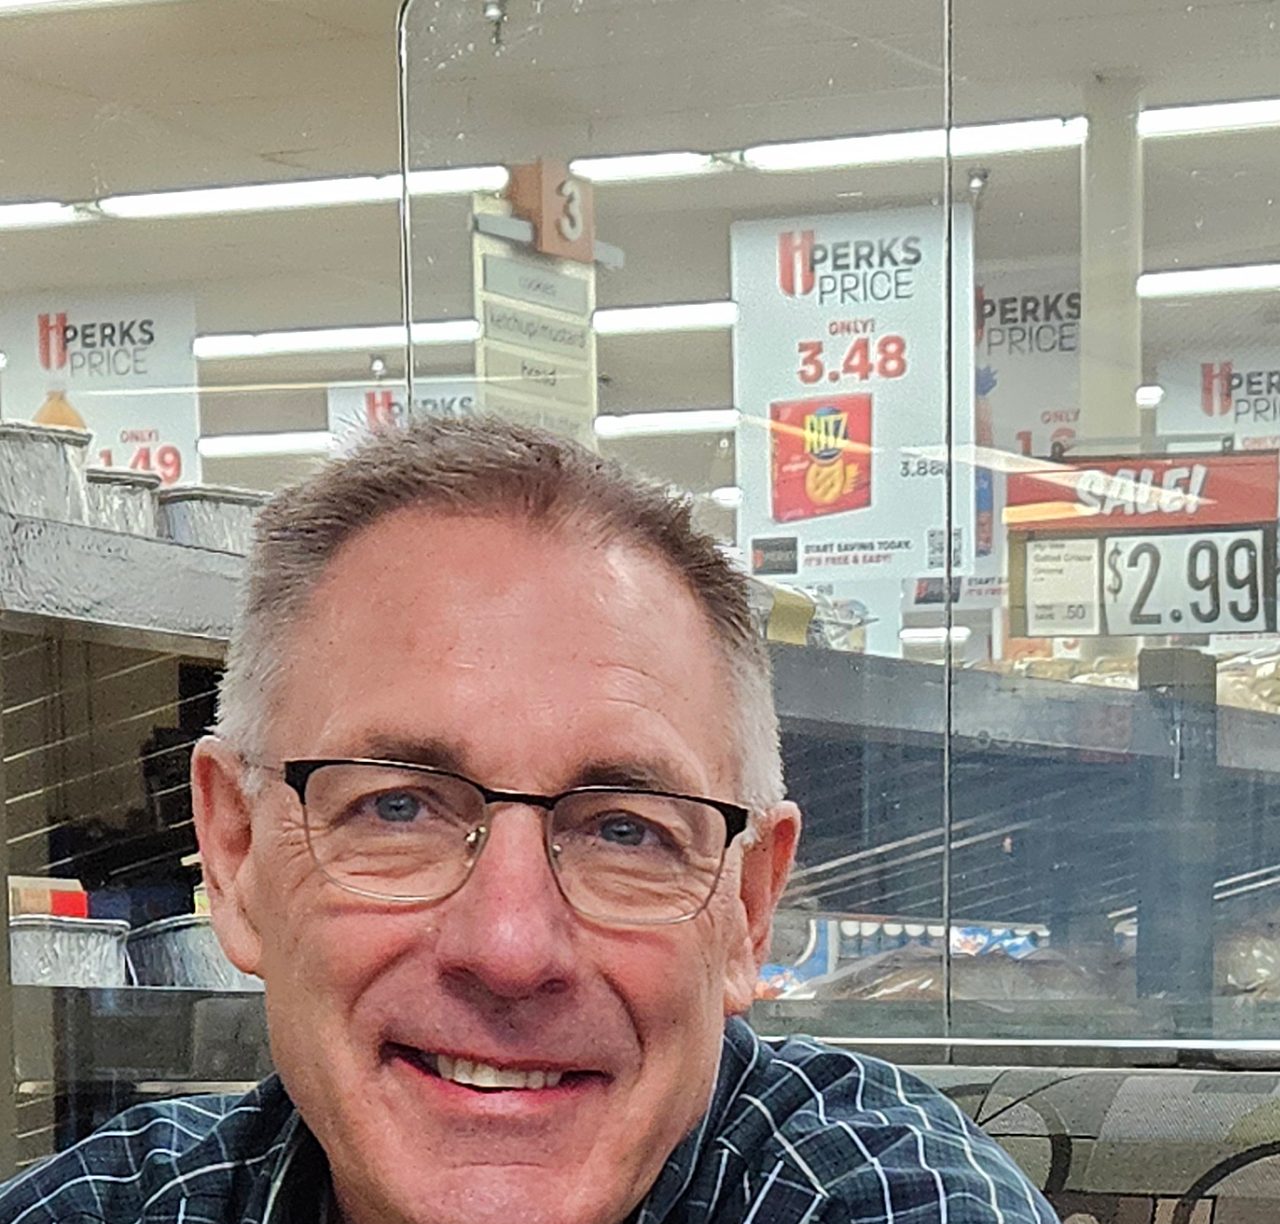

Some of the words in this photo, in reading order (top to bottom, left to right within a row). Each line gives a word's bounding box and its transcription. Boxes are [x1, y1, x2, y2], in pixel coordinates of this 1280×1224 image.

[557, 180, 581, 241] 3
[819, 268, 913, 305] PRICE
[797, 335, 907, 384] 3.48
[987, 323, 1078, 355] PRICE
[71, 346, 148, 376] PRICE
[1077, 464, 1207, 516] SALE!
